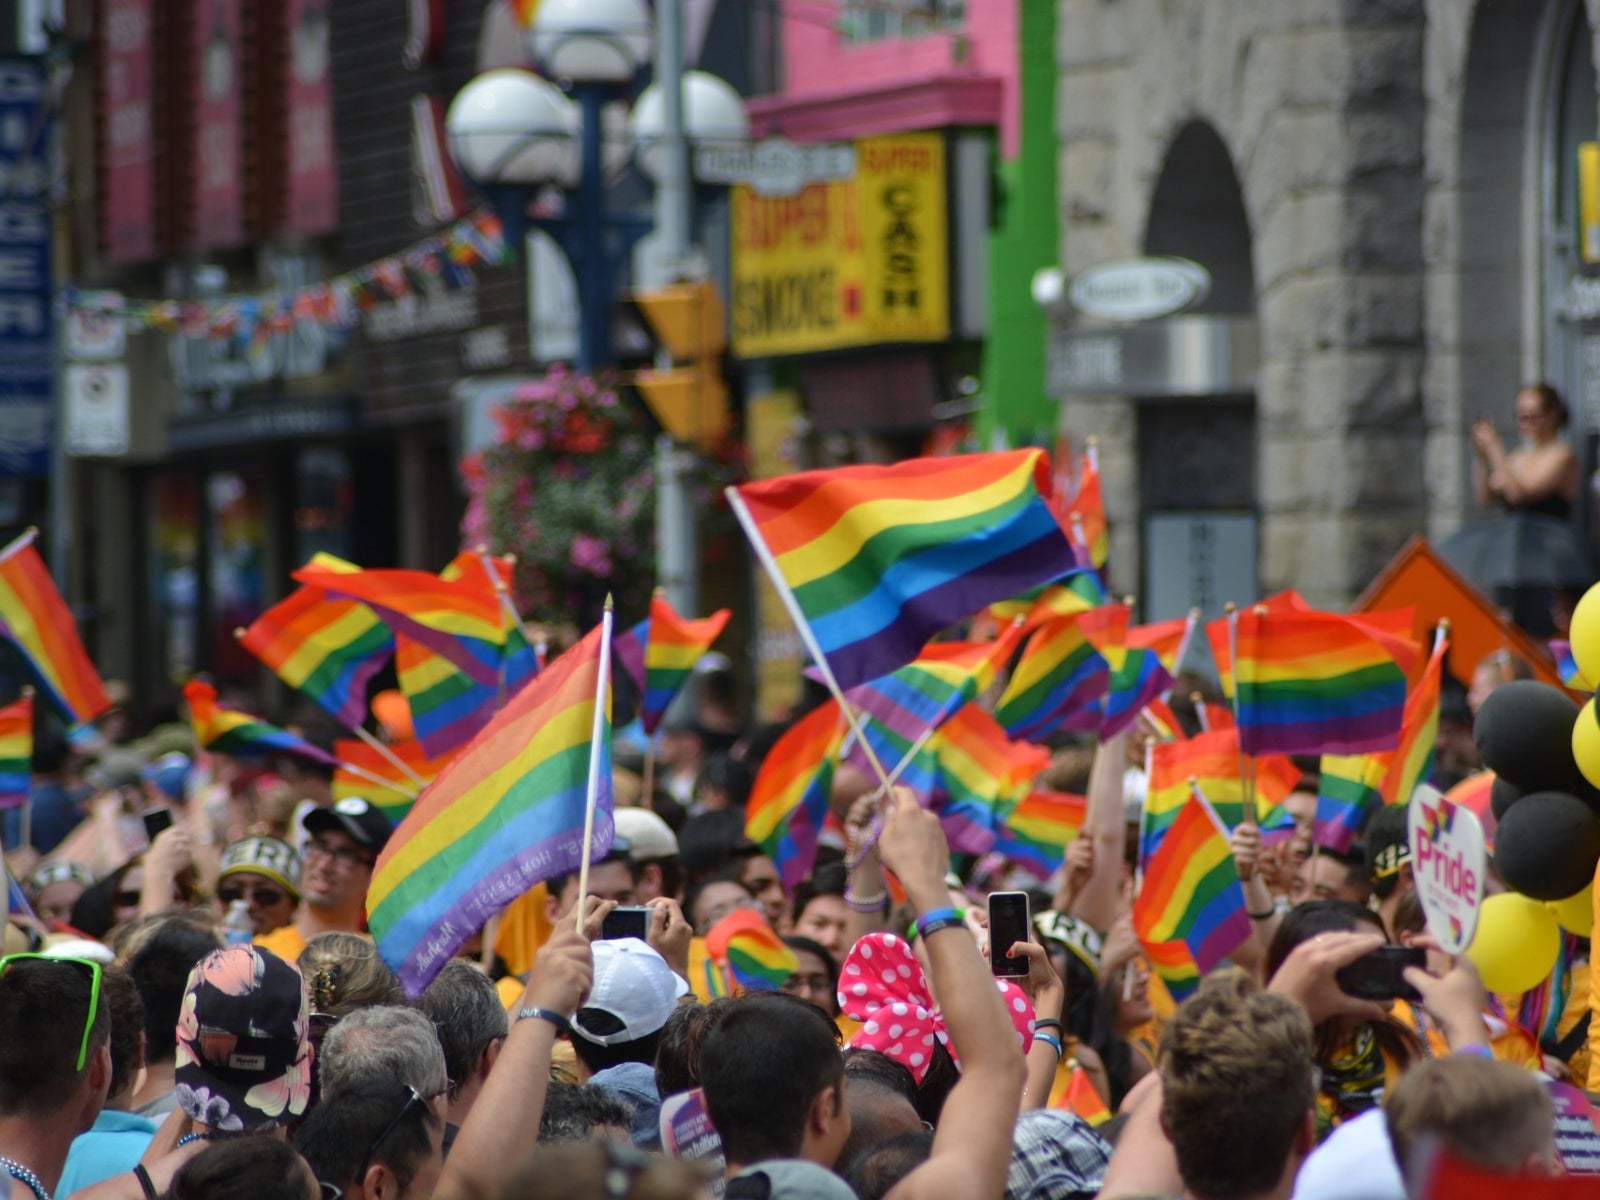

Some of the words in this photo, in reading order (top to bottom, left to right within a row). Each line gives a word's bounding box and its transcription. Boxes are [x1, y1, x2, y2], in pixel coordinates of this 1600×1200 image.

[882, 185, 920, 311] CASH
[735, 266, 835, 338] SMOKE
[1416, 826, 1476, 907] Pride
